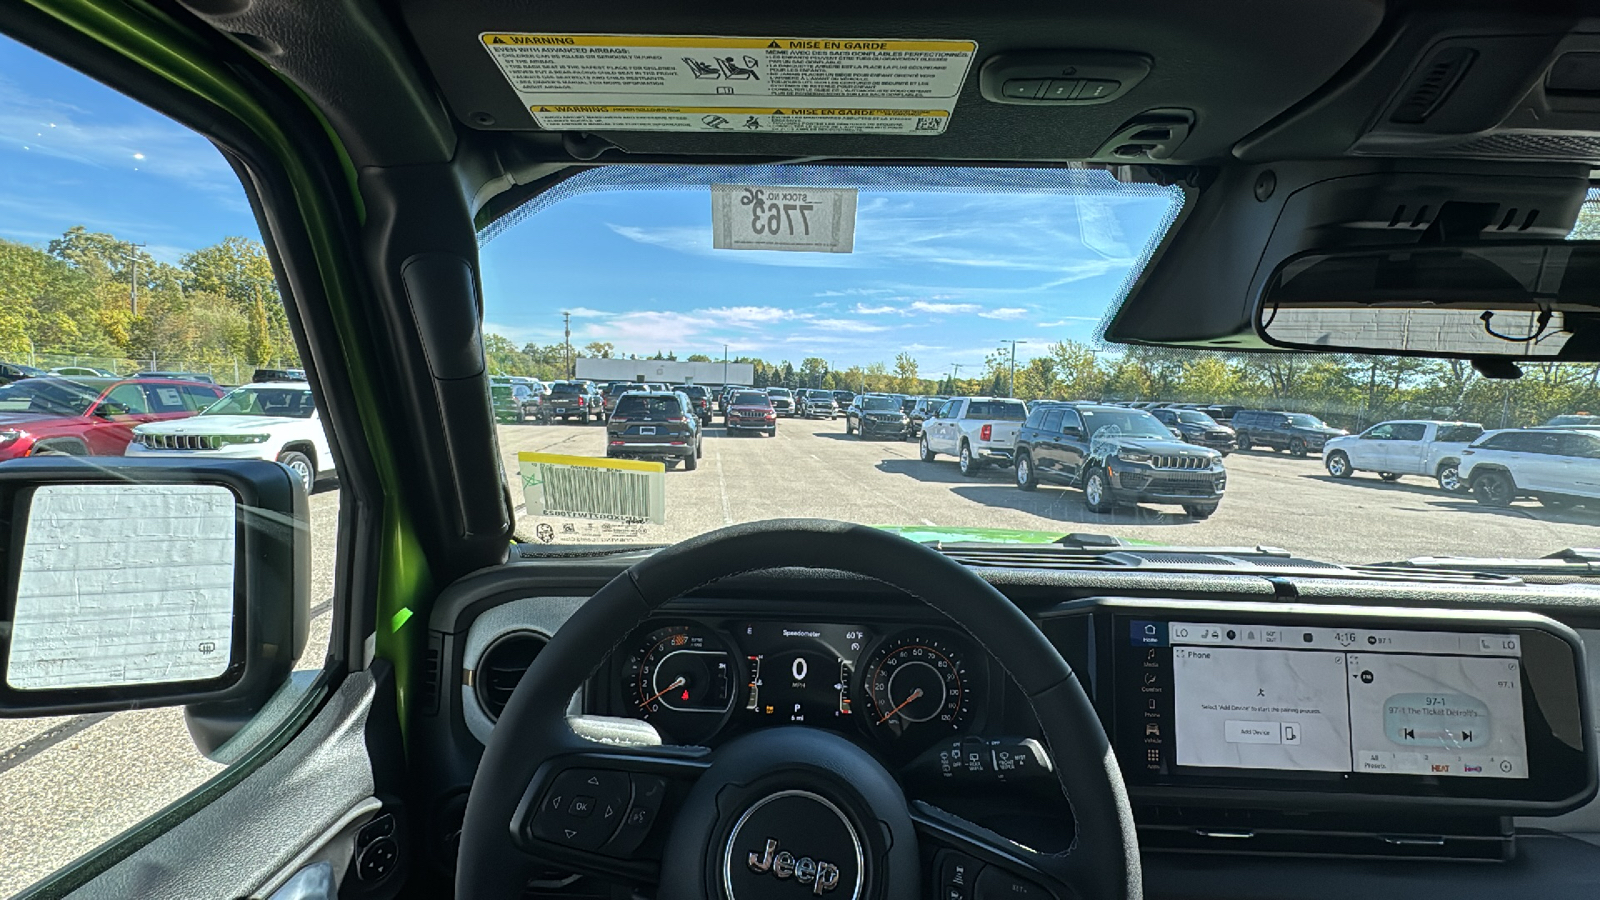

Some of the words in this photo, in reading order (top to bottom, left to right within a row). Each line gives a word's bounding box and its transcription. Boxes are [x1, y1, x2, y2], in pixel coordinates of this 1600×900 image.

[510, 36, 574, 44] WARNING
[789, 41, 820, 49] MISE
[783, 629, 820, 638] Speedometer
[1175, 628, 1188, 638] LO
[1335, 633, 1356, 642] 4:16
[1502, 640, 1516, 649] LO
[912, 648, 922, 656] 60
[1187, 651, 1211, 659] Phone
[887, 658, 897, 666] 40
[792, 658, 808, 680] 0
[875, 683, 884, 691] 20
[1497, 681, 1514, 689] 97.1
[1426, 697, 1446, 706] 97-1
[652, 704, 658, 712] 0
[794, 704, 801, 712] P
[1422, 708, 1445, 716] Ticket
[576, 802, 587, 812] OK
[748, 839, 840, 895] Jeep
